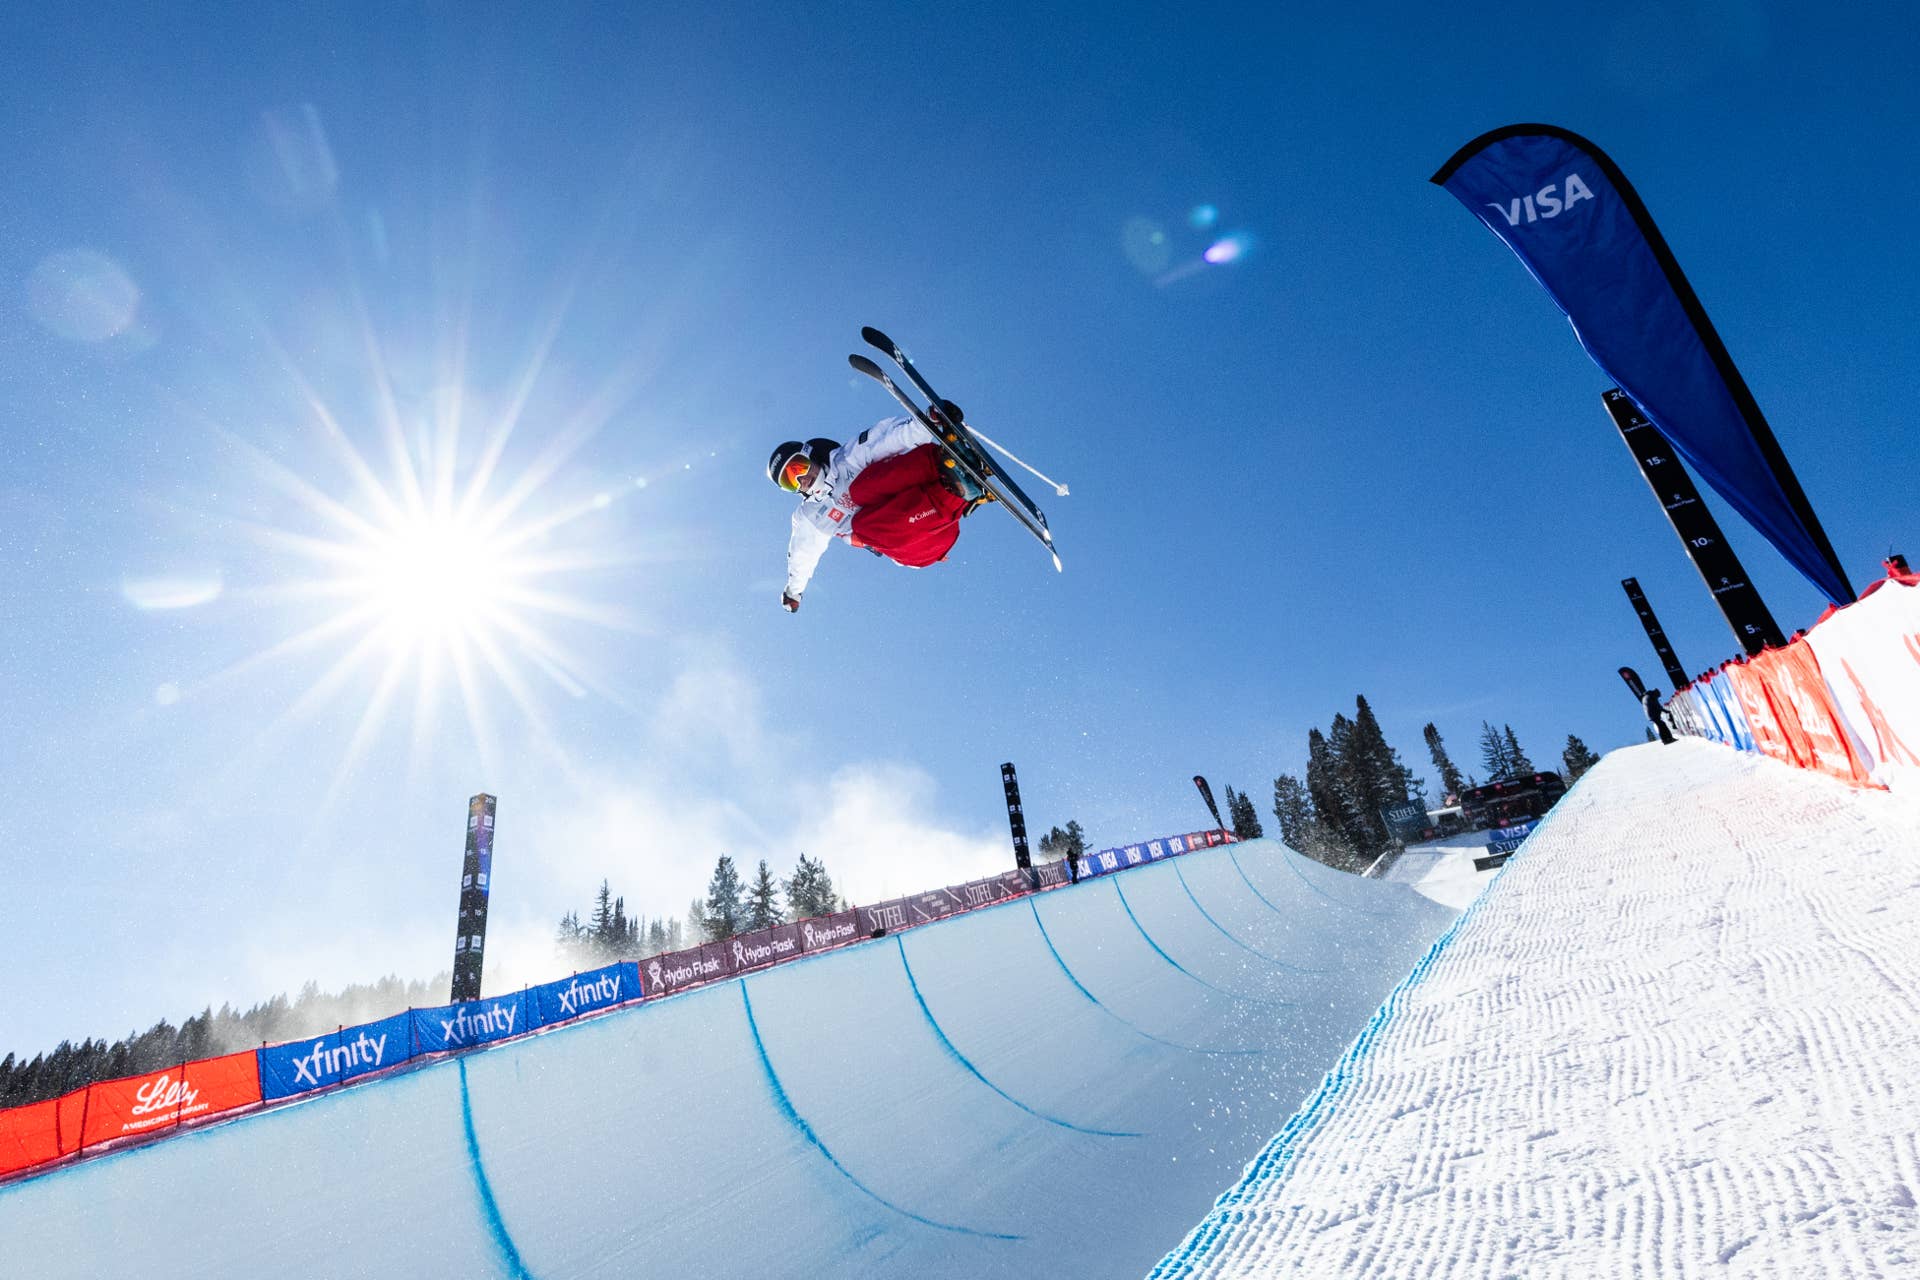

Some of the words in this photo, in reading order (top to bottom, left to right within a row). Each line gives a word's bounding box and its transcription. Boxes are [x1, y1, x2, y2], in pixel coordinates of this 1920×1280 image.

[1484, 172, 1595, 227] VISA
[1645, 455, 1661, 467] 15
[1690, 537, 1708, 549] 10
[1744, 623, 1756, 635] 5
[1388, 806, 1417, 820] STIFEL
[1500, 824, 1531, 839] VISA
[1077, 859, 1093, 879] ISA
[1098, 851, 1119, 870] VISA
[965, 883, 994, 906] STIFEL
[867, 904, 907, 932] STIFEL
[814, 928, 837, 944] Hydro
[837, 923, 856, 937] Flask
[744, 944, 771, 963] Hydro
[772, 938, 795, 954] Flask
[664, 964, 693, 986] Hydro
[693, 958, 720, 976] Flask
[557, 974, 621, 1014] xfinity
[440, 1001, 518, 1045] xfinity
[292, 1031, 388, 1085] xfinity
[131, 1075, 199, 1115] Lilly
[129, 1113, 169, 1130] MEDICINE
[169, 1103, 209, 1119] COMPANY
